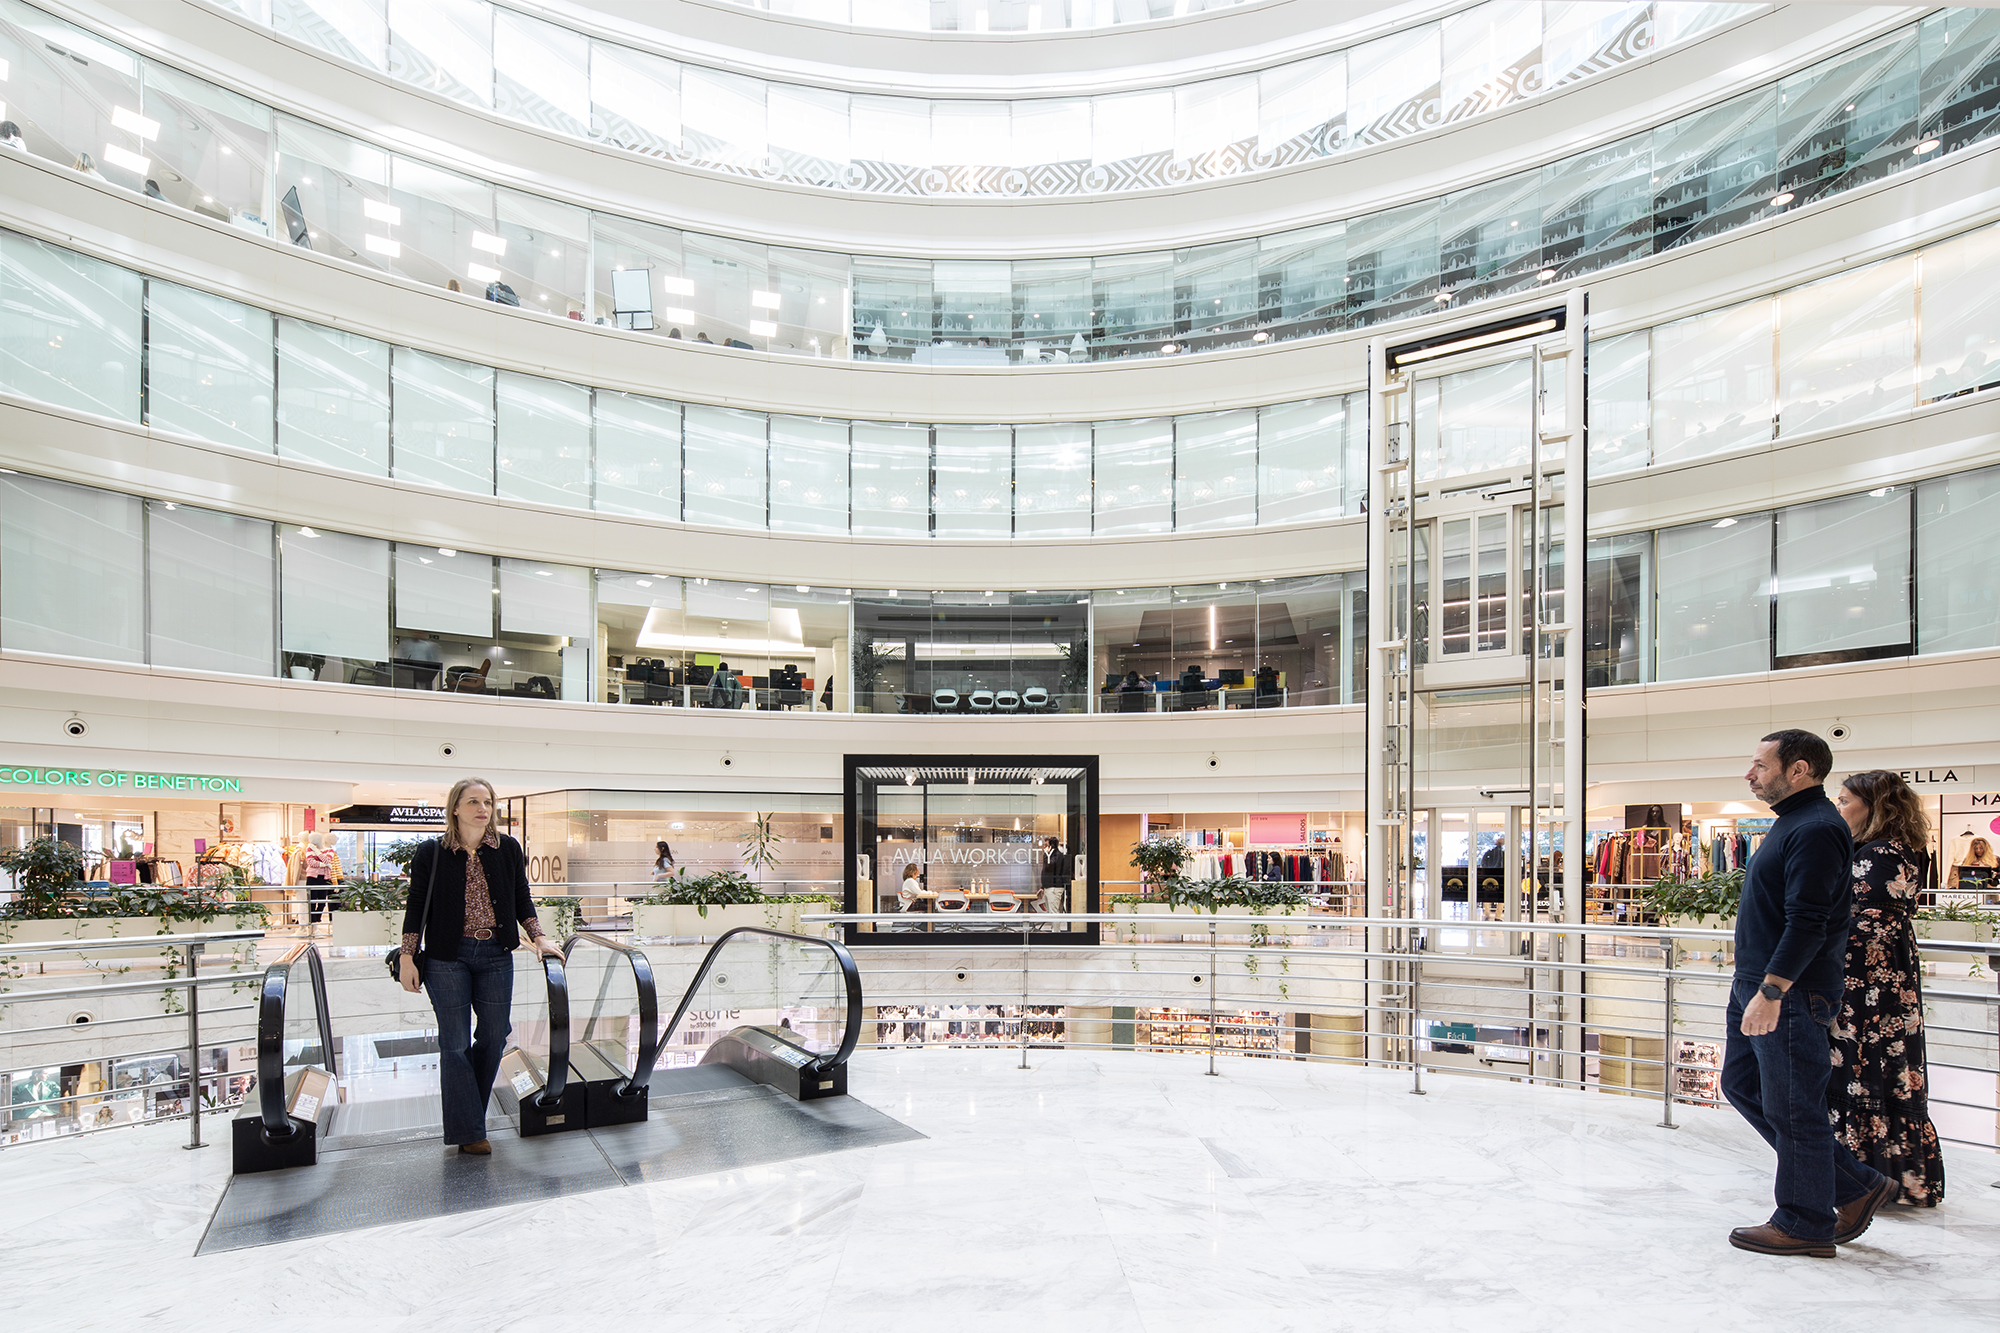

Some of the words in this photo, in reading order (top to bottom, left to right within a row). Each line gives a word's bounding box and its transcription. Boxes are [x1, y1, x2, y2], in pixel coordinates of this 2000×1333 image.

[0, 768, 92, 787] COLORS
[97, 772, 128, 787] OF
[1900, 769, 1958, 783] ELLA
[390, 807, 447, 816] AVILASPAC
[892, 848, 945, 864] AVILA
[950, 848, 1008, 864] WORK
[1014, 848, 1055, 864] CITY
[530, 855, 566, 883] one.
